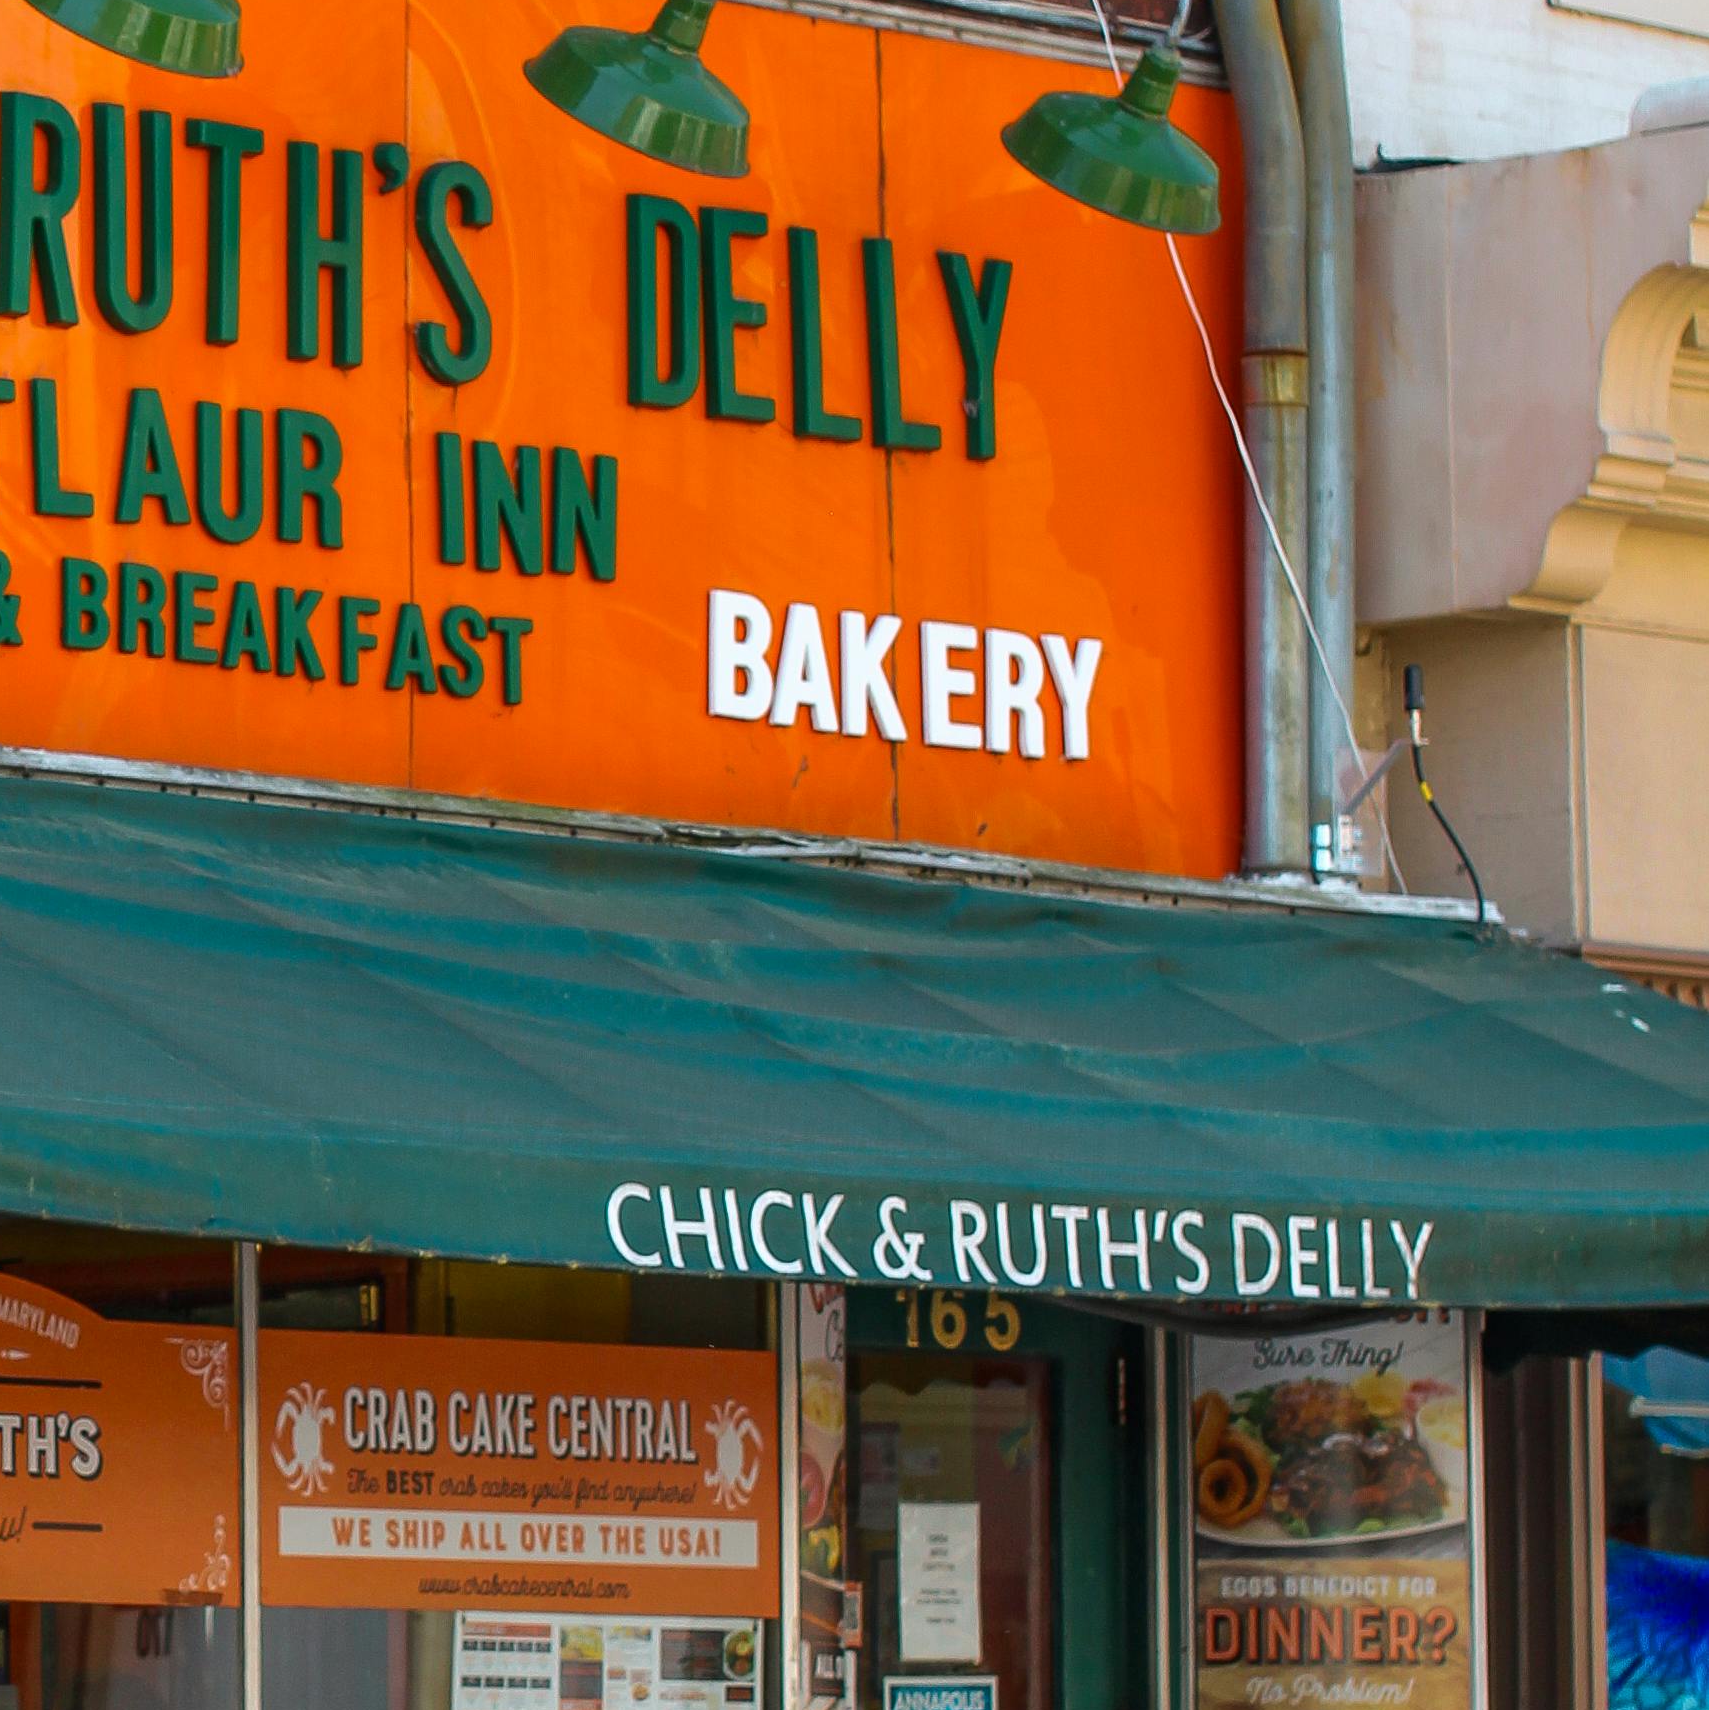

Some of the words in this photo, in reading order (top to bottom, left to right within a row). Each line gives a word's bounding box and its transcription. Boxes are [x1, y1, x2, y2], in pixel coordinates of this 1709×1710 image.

[627, 193, 1013, 461] DELLY
[436, 431, 618, 581] INN
[60, 557, 534, 706] BREAKFAST
[707, 588, 1103, 761] BAKERY
[606, 1182, 858, 1278] CHICK
[873, 1194, 933, 1281] &
[950, 1198, 1211, 1296] RUTH'S
[1231, 1212, 1435, 1300] DELLY
[1253, 1337, 1315, 1370] Sure
[1321, 1338, 1404, 1378] Thing!
[343, 1386, 437, 1454] CRAB
[447, 1392, 537, 1459] CAKE
[546, 1394, 698, 1466] CENTRAL
[346, 1468, 379, 1495] The
[386, 1469, 434, 1495] BEST
[439, 1473, 475, 1497] crab
[481, 1476, 528, 1500] cakes
[574, 1476, 610, 1509] find
[332, 1516, 371, 1548] WE
[386, 1518, 445, 1551] SHIP
[460, 1521, 507, 1552] ALL
[520, 1523, 585, 1554] OVER
[599, 1525, 646, 1556] THE
[658, 1526, 722, 1558] USA!
[1220, 1575, 1278, 1598] EGGS
[1283, 1575, 1389, 1598] BENEDICT
[1397, 1575, 1437, 1598] FOR
[1204, 1605, 1457, 1664] DINNER?
[1245, 1676, 1287, 1705] No
